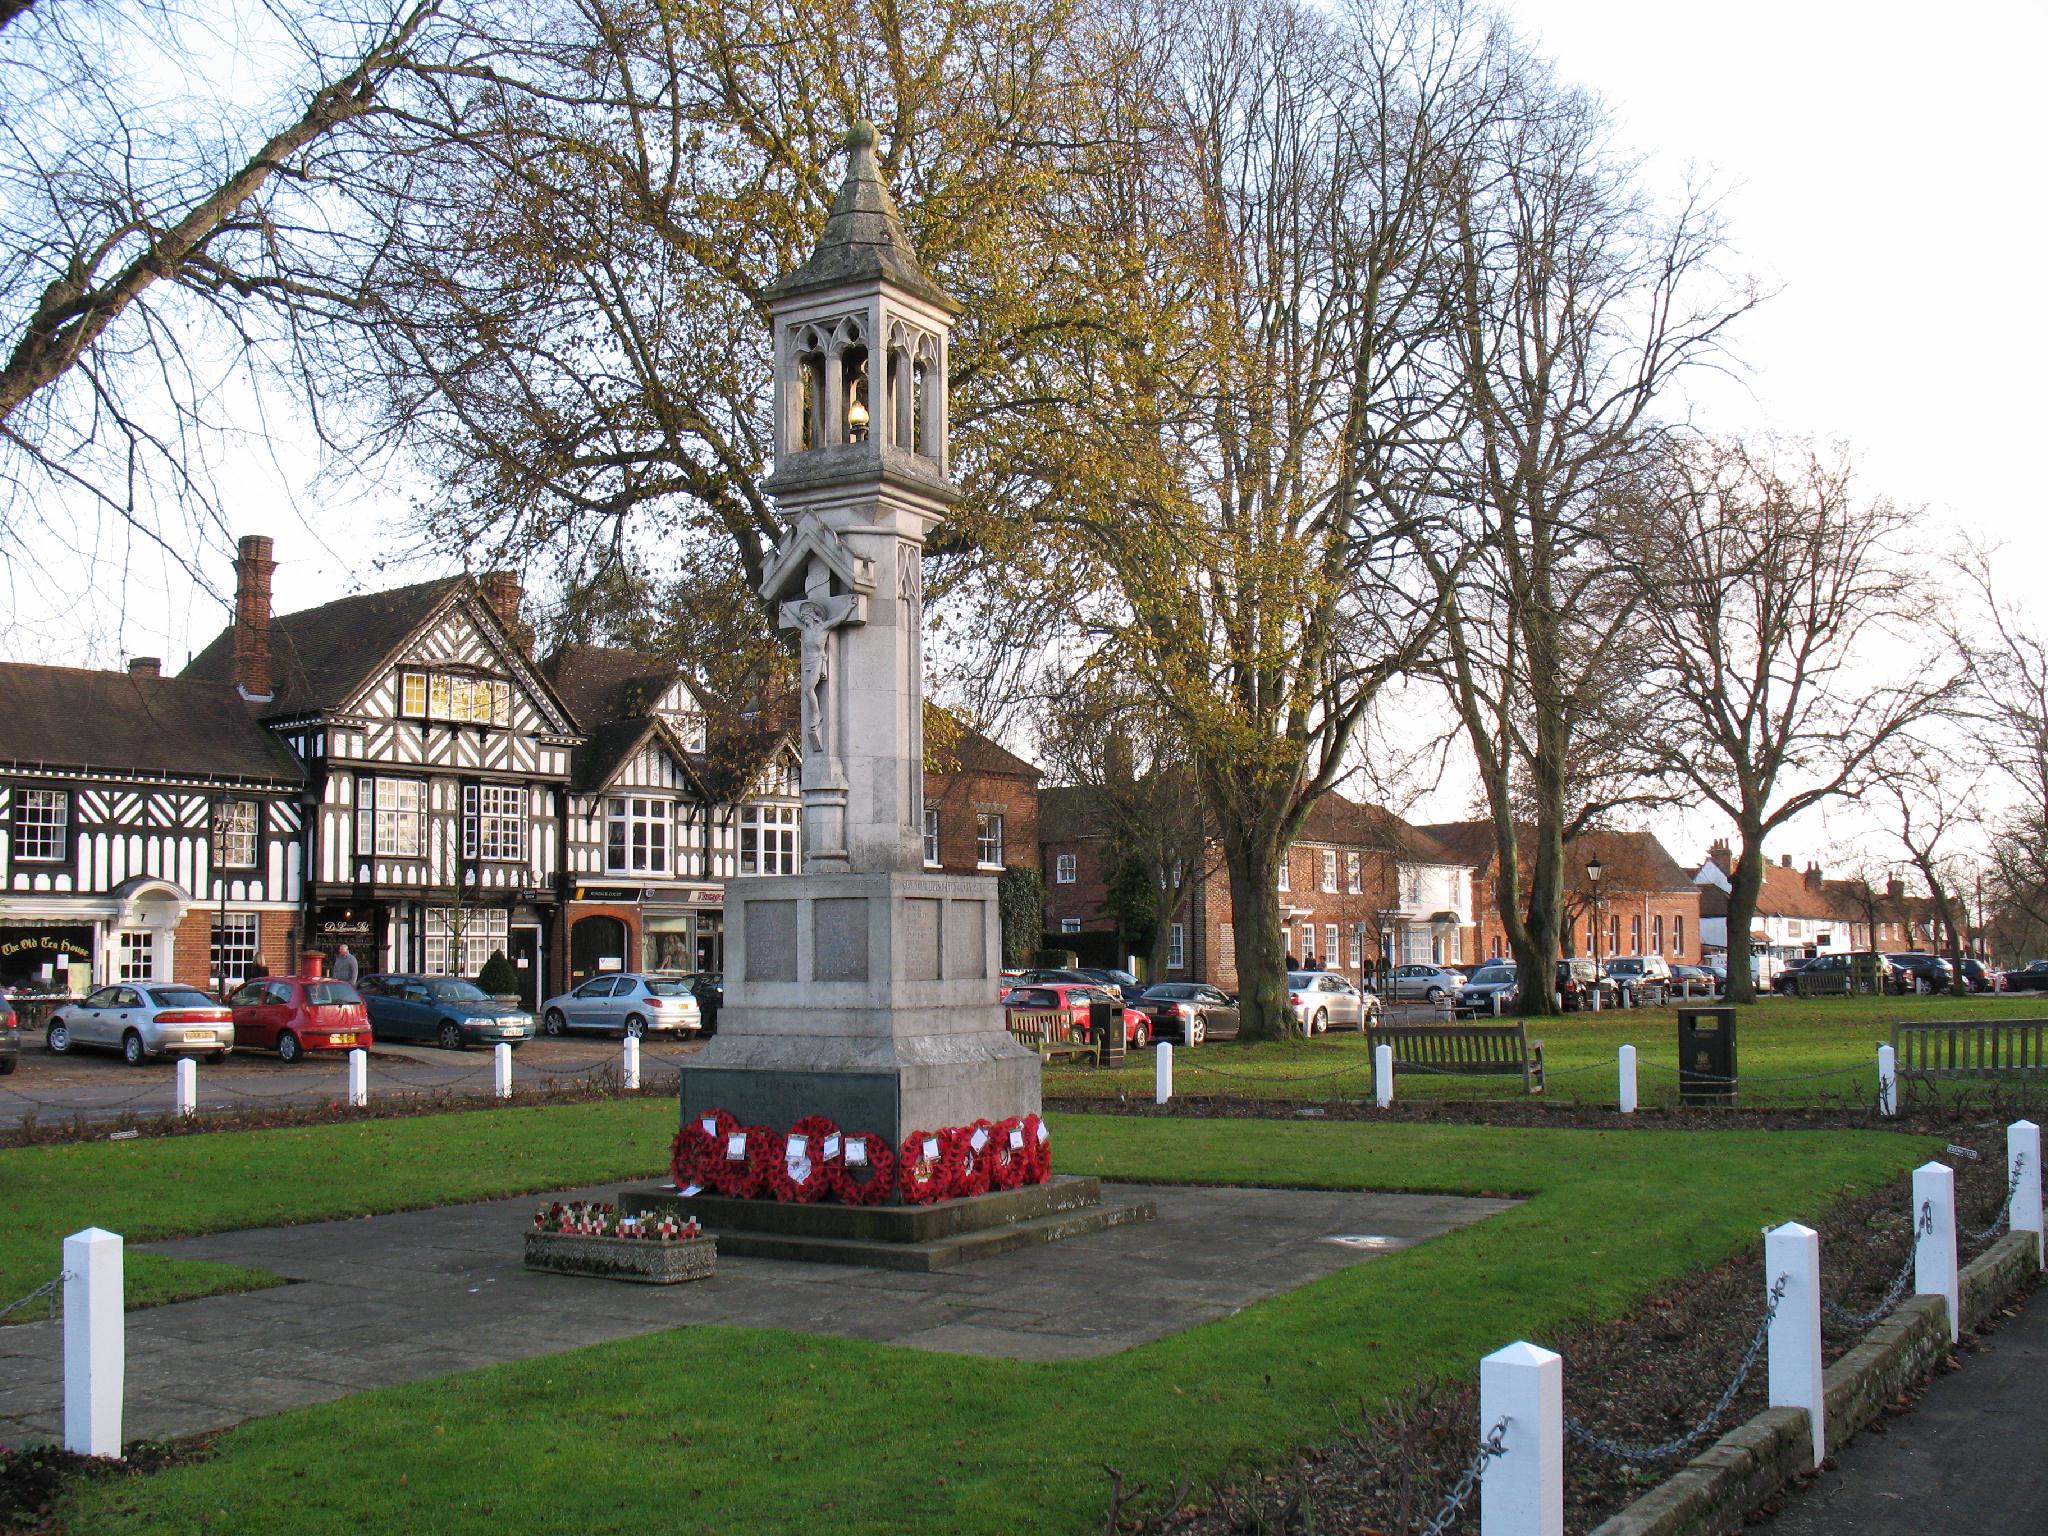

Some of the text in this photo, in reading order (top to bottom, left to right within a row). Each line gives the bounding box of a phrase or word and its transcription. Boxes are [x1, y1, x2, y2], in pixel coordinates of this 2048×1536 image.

[140, 913, 146, 922] 7
[1, 936, 89, 957] The Old Tea House
